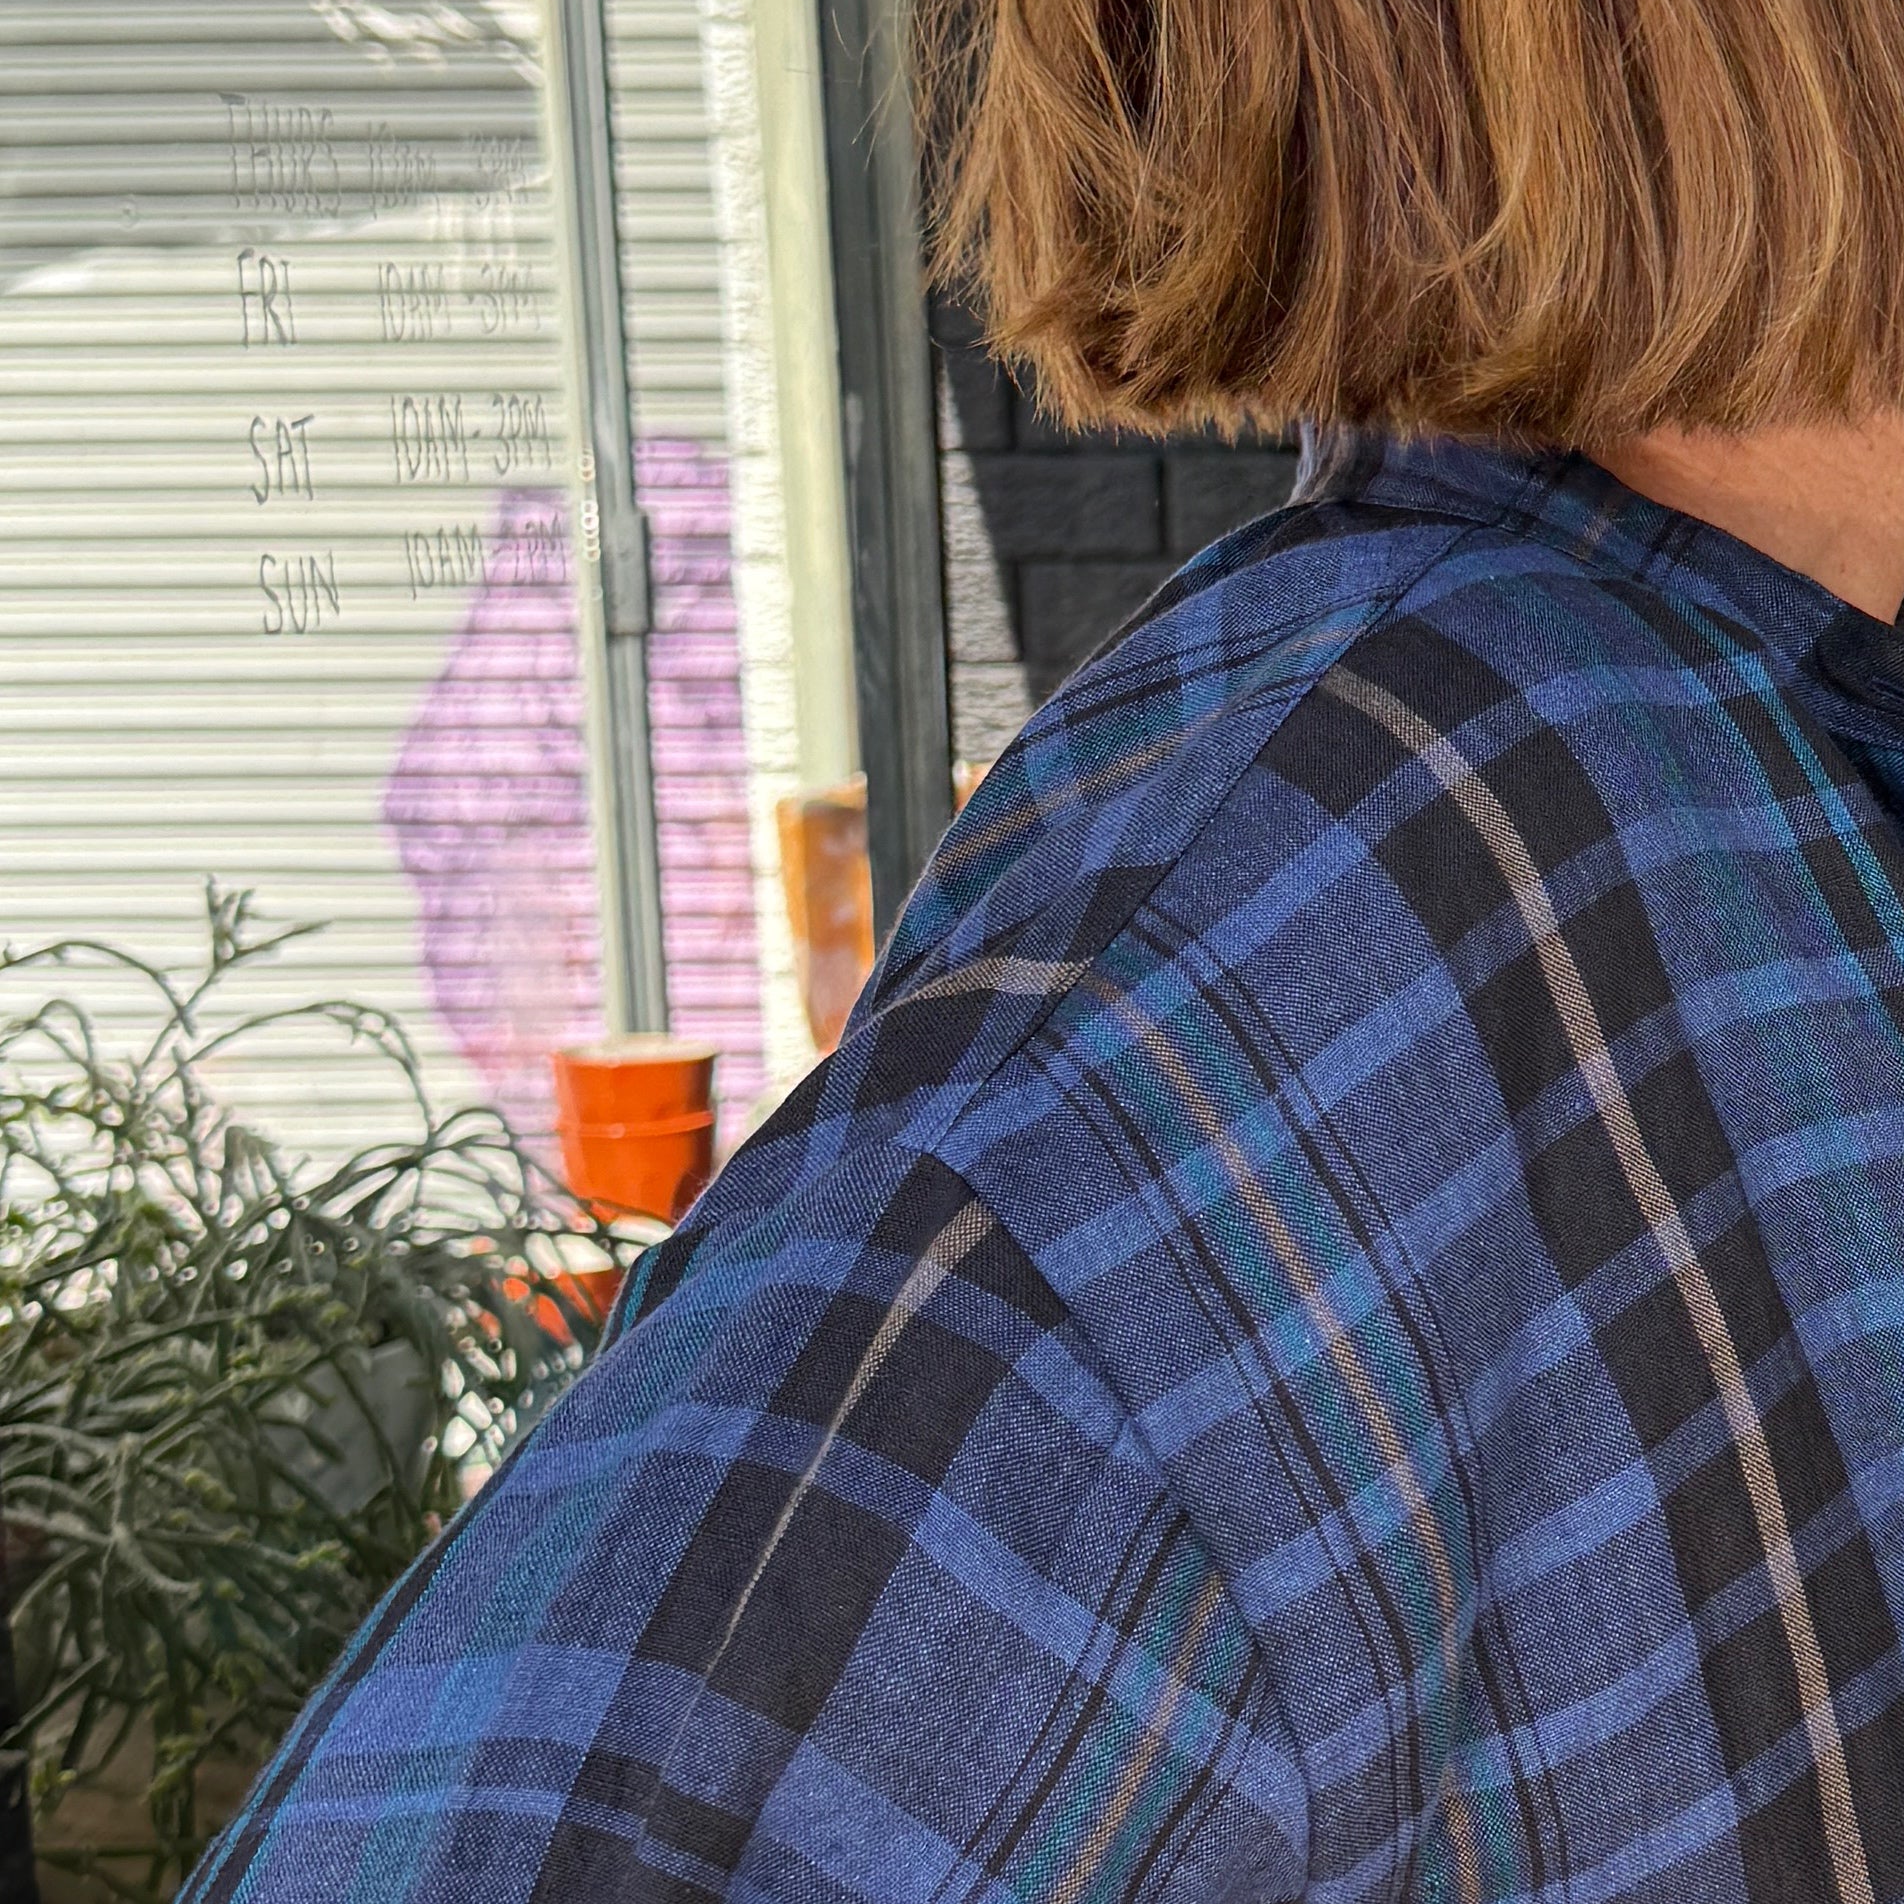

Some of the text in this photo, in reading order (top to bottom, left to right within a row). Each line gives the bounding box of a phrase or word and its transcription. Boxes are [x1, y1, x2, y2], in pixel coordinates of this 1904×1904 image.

[219, 92, 342, 219] THURS
[236, 247, 297, 350] FRI
[249, 413, 315, 506] SAT
[258, 548, 341, 635] SUN
